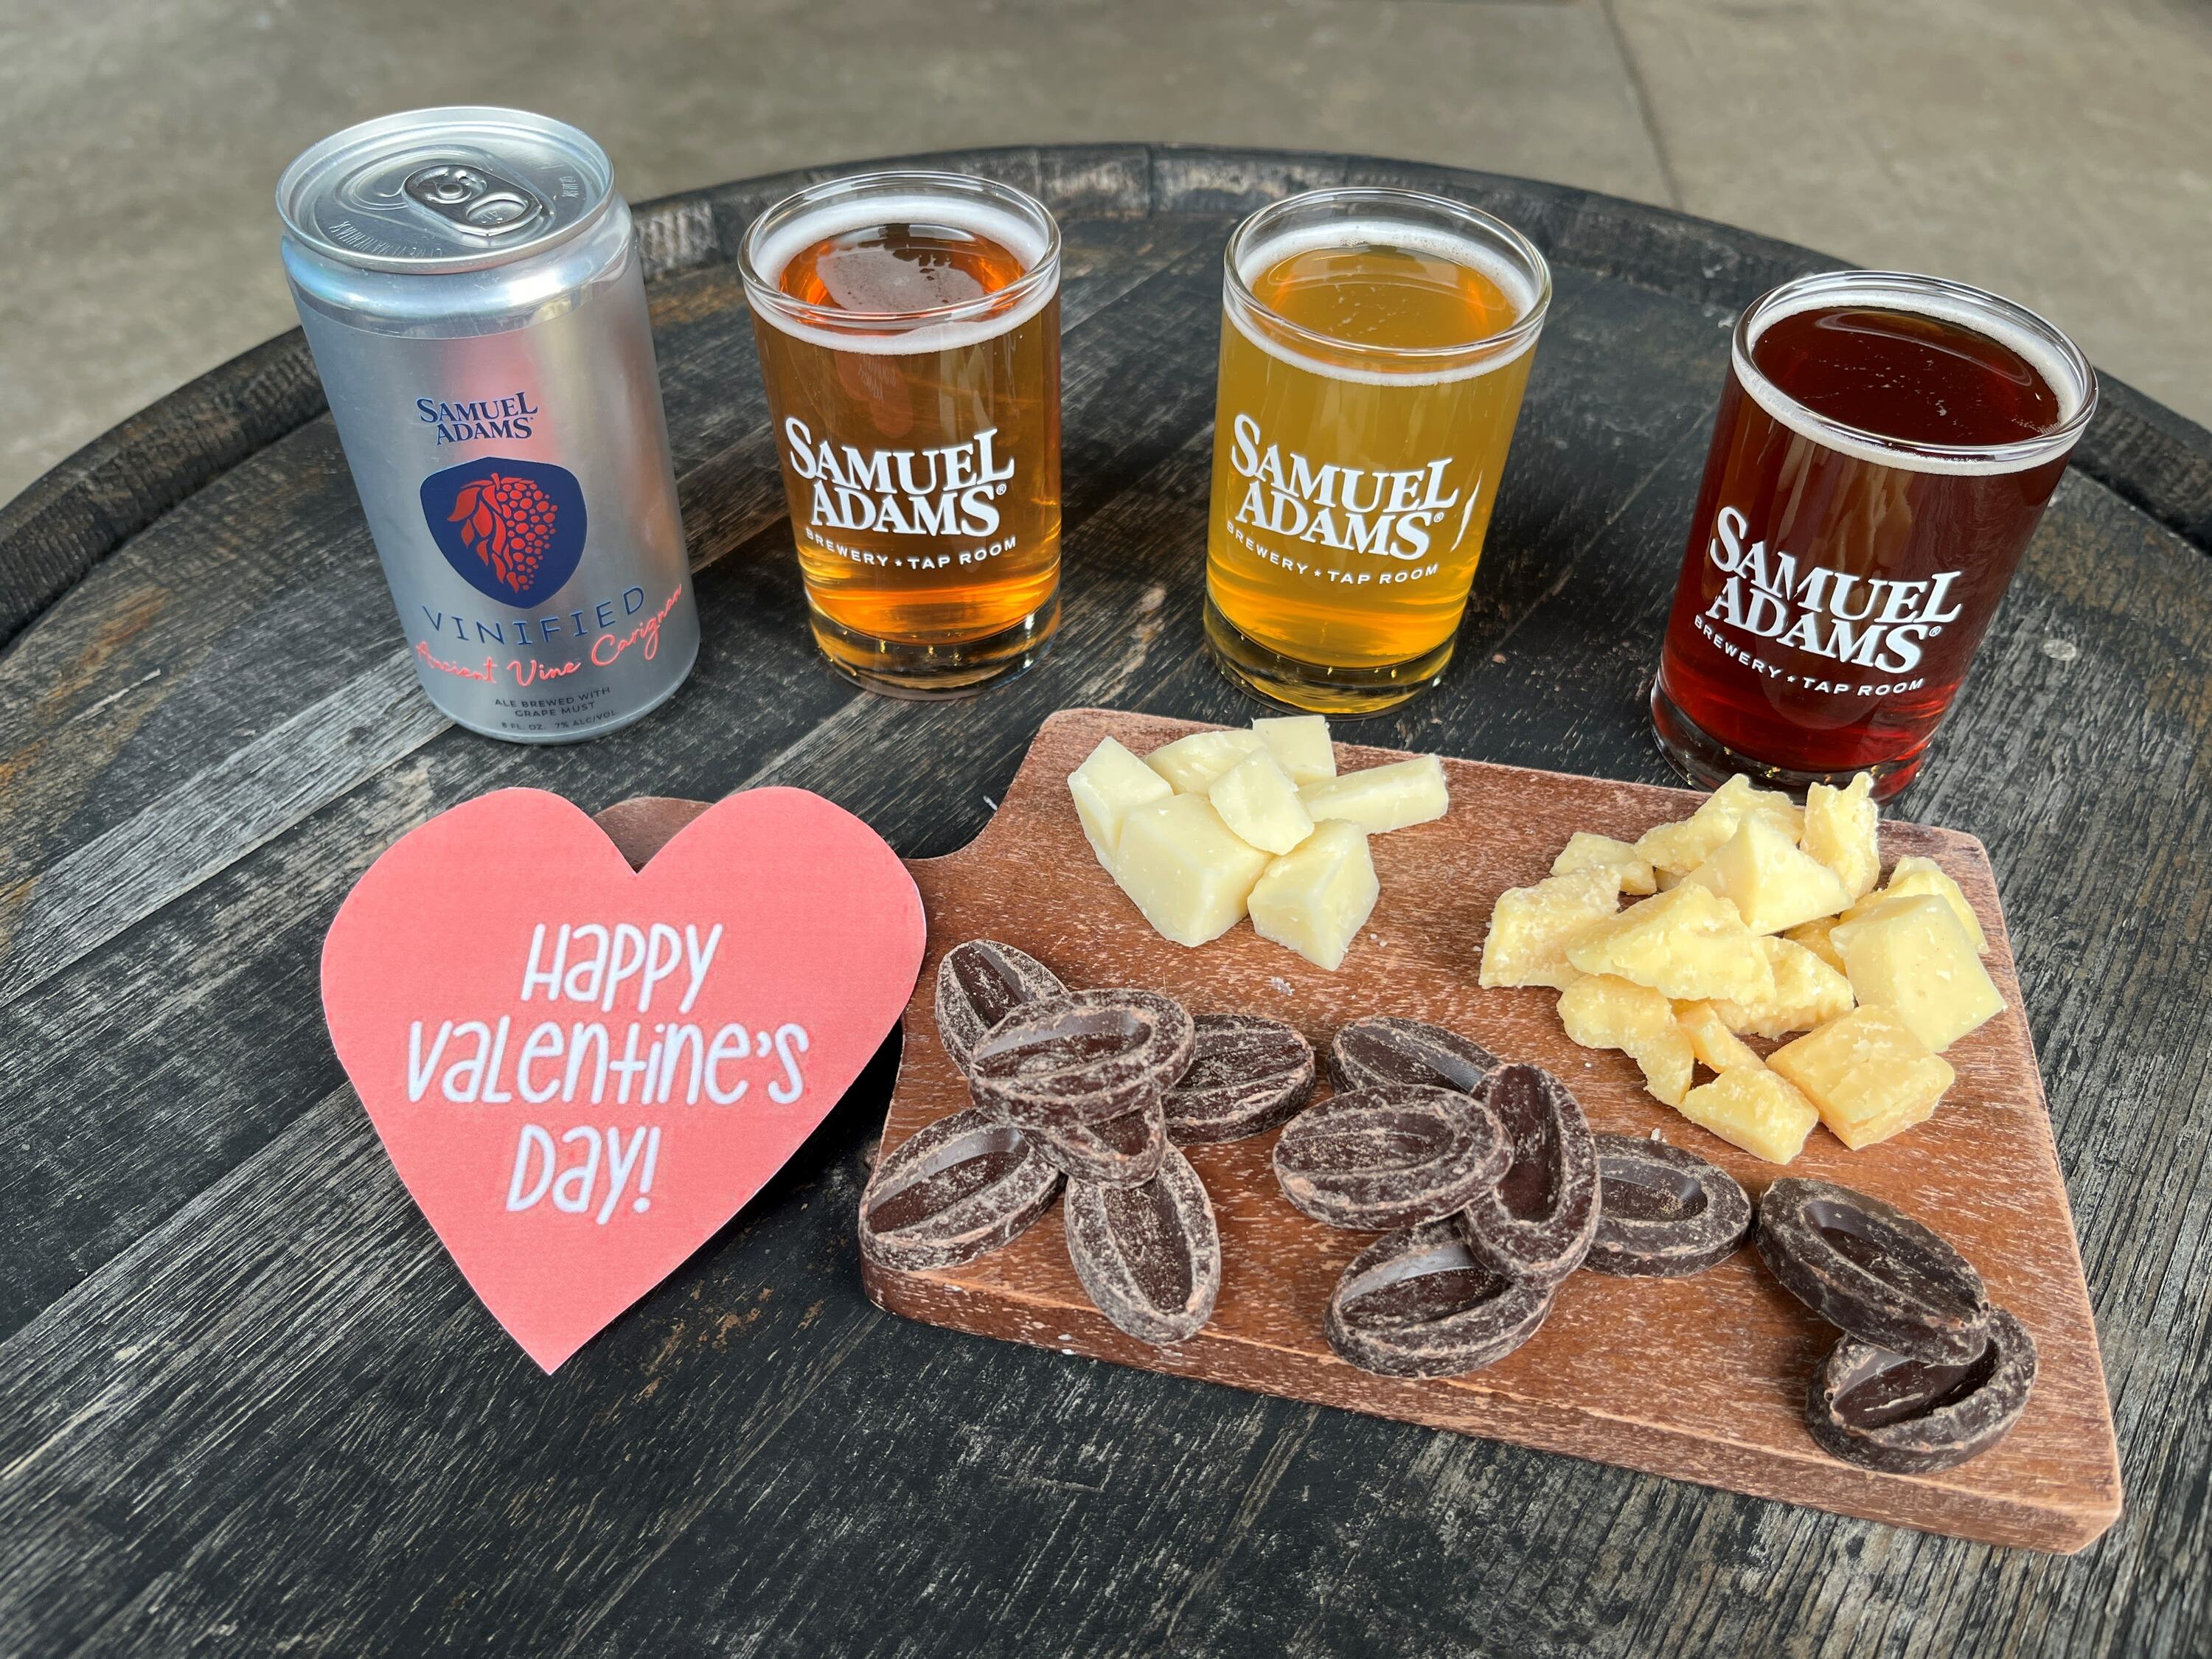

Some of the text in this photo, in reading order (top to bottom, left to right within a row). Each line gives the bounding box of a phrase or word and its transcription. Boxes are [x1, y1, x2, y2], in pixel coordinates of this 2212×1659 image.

[416, 391, 538, 423] SAMUEL
[437, 417, 533, 445] ADAMS
[785, 417, 1015, 495] SAMUEL
[1230, 413, 1459, 514] SAMUEL
[805, 526, 1017, 570] BREWERY TAP ROOM
[1227, 521, 1439, 585] BREWERY TAP ROOM
[1709, 506, 1963, 624] SAMUEL
[421, 585, 644, 646] VINIFIED
[415, 641, 498, 684] Ancient
[507, 659, 581, 687] Vine
[1694, 614, 1924, 697] BREWERY TAP ROOM
[495, 686, 611, 709] ALE BREWED WITH
[515, 701, 595, 717] GRAPE MUST
